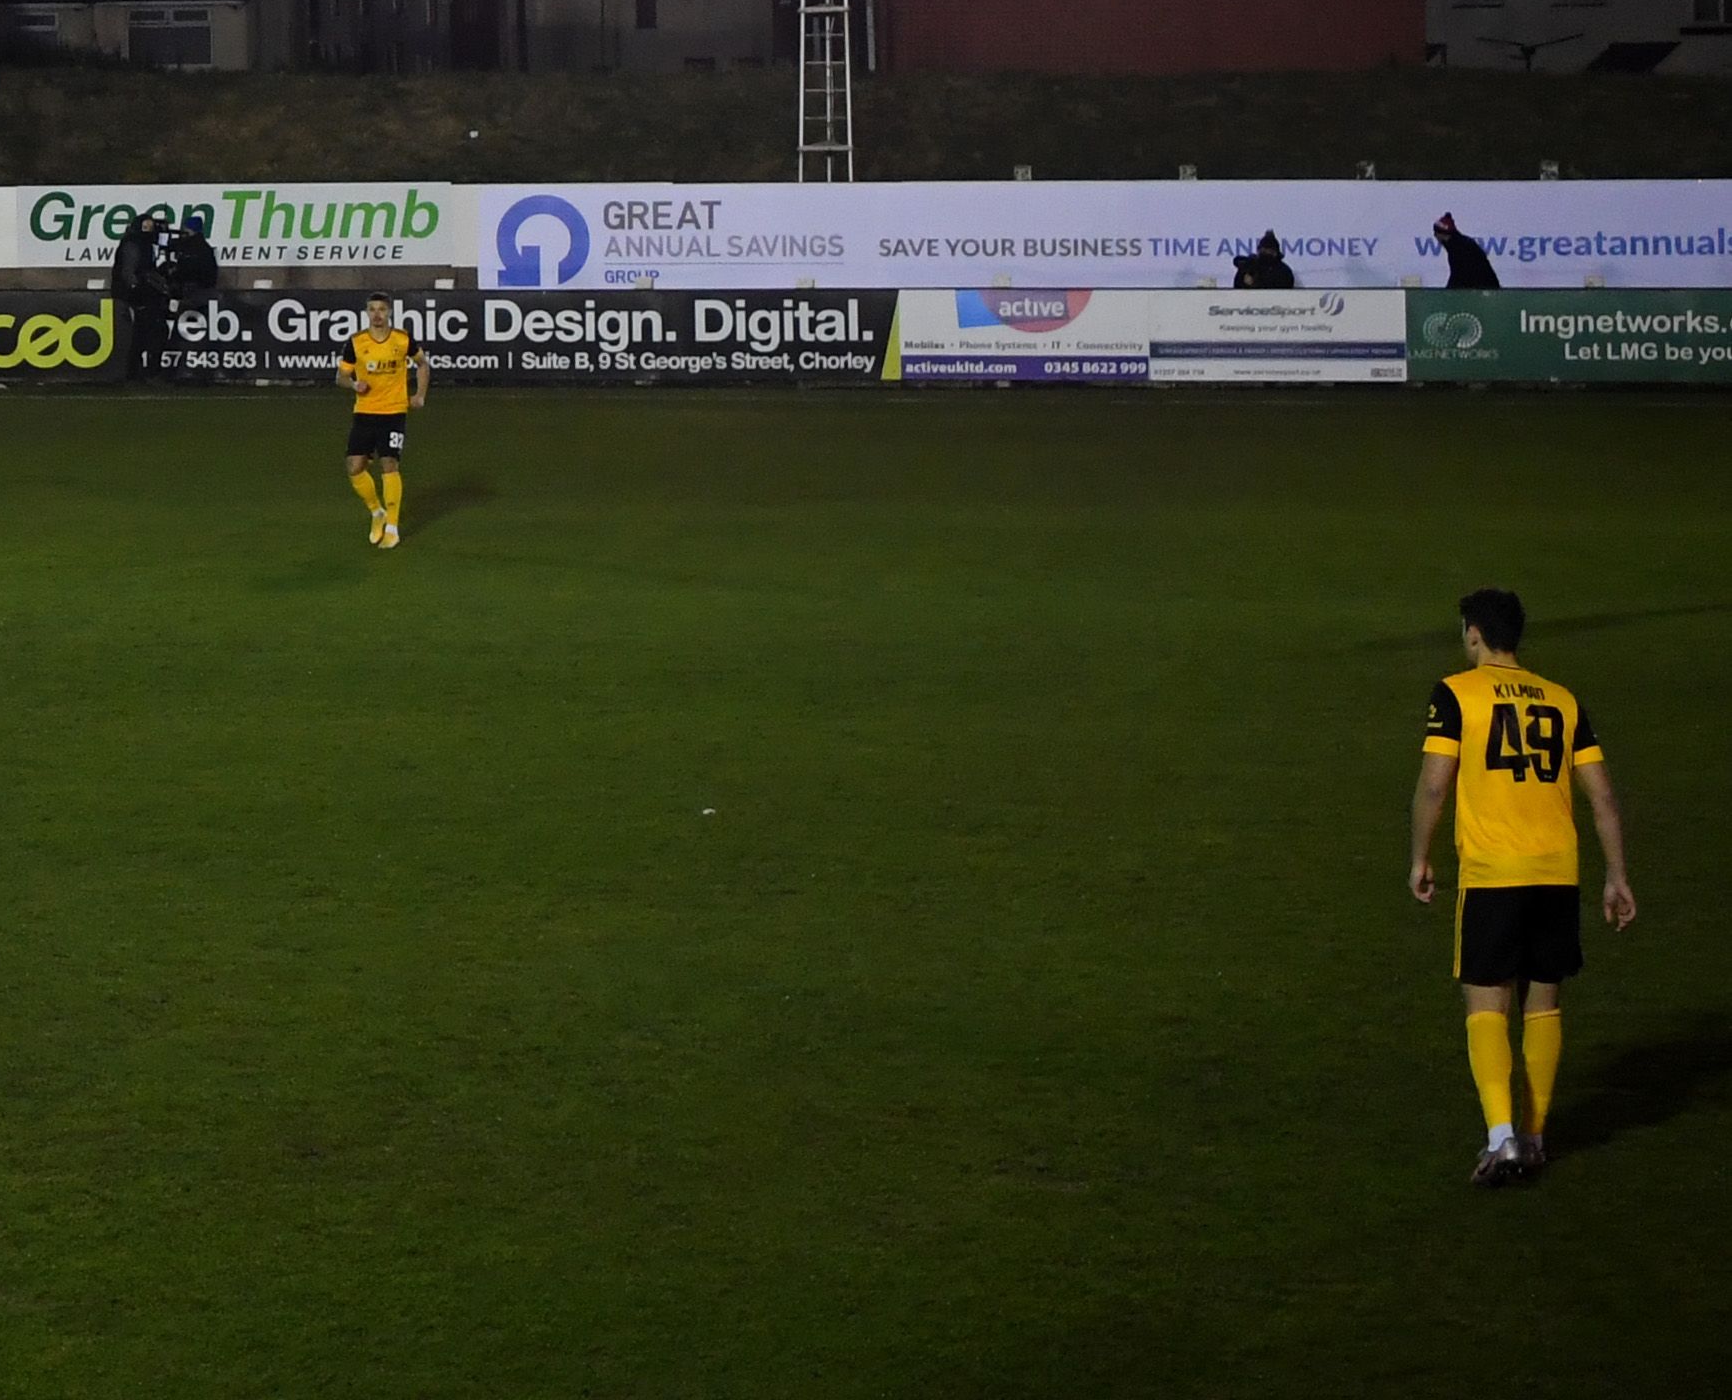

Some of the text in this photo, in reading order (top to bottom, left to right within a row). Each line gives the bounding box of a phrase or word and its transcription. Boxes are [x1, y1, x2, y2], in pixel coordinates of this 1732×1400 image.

[603, 200, 722, 231] GREAT
[64, 247, 115, 262] LAW
[296, 245, 404, 261] SERVICE
[604, 233, 845, 258] ANNUAL SAVINGS
[878, 237, 1378, 258] SAVE YOUR BUSINESS TIME AN MONEY
[1414, 227, 1732, 261] ww.greatannual
[998, 298, 1066, 317] active
[484, 298, 677, 353] Design.
[694, 298, 874, 353] Digital.
[1520, 309, 1732, 341] lmgnetworks.
[904, 340, 1144, 354] Mobiles Phone Systems IT Connectivity
[1564, 342, 1601, 361] Let
[1606, 342, 1659, 361] LMG
[1665, 342, 1694, 361] be
[185, 350, 876, 374] 543 503 Suite B, 9 St George's Street, Chorley
[905, 361, 1147, 375] activeukltd.com 0345 8622 999
[1492, 682, 1545, 701] KILMAN
[1485, 702, 1566, 784] 49
